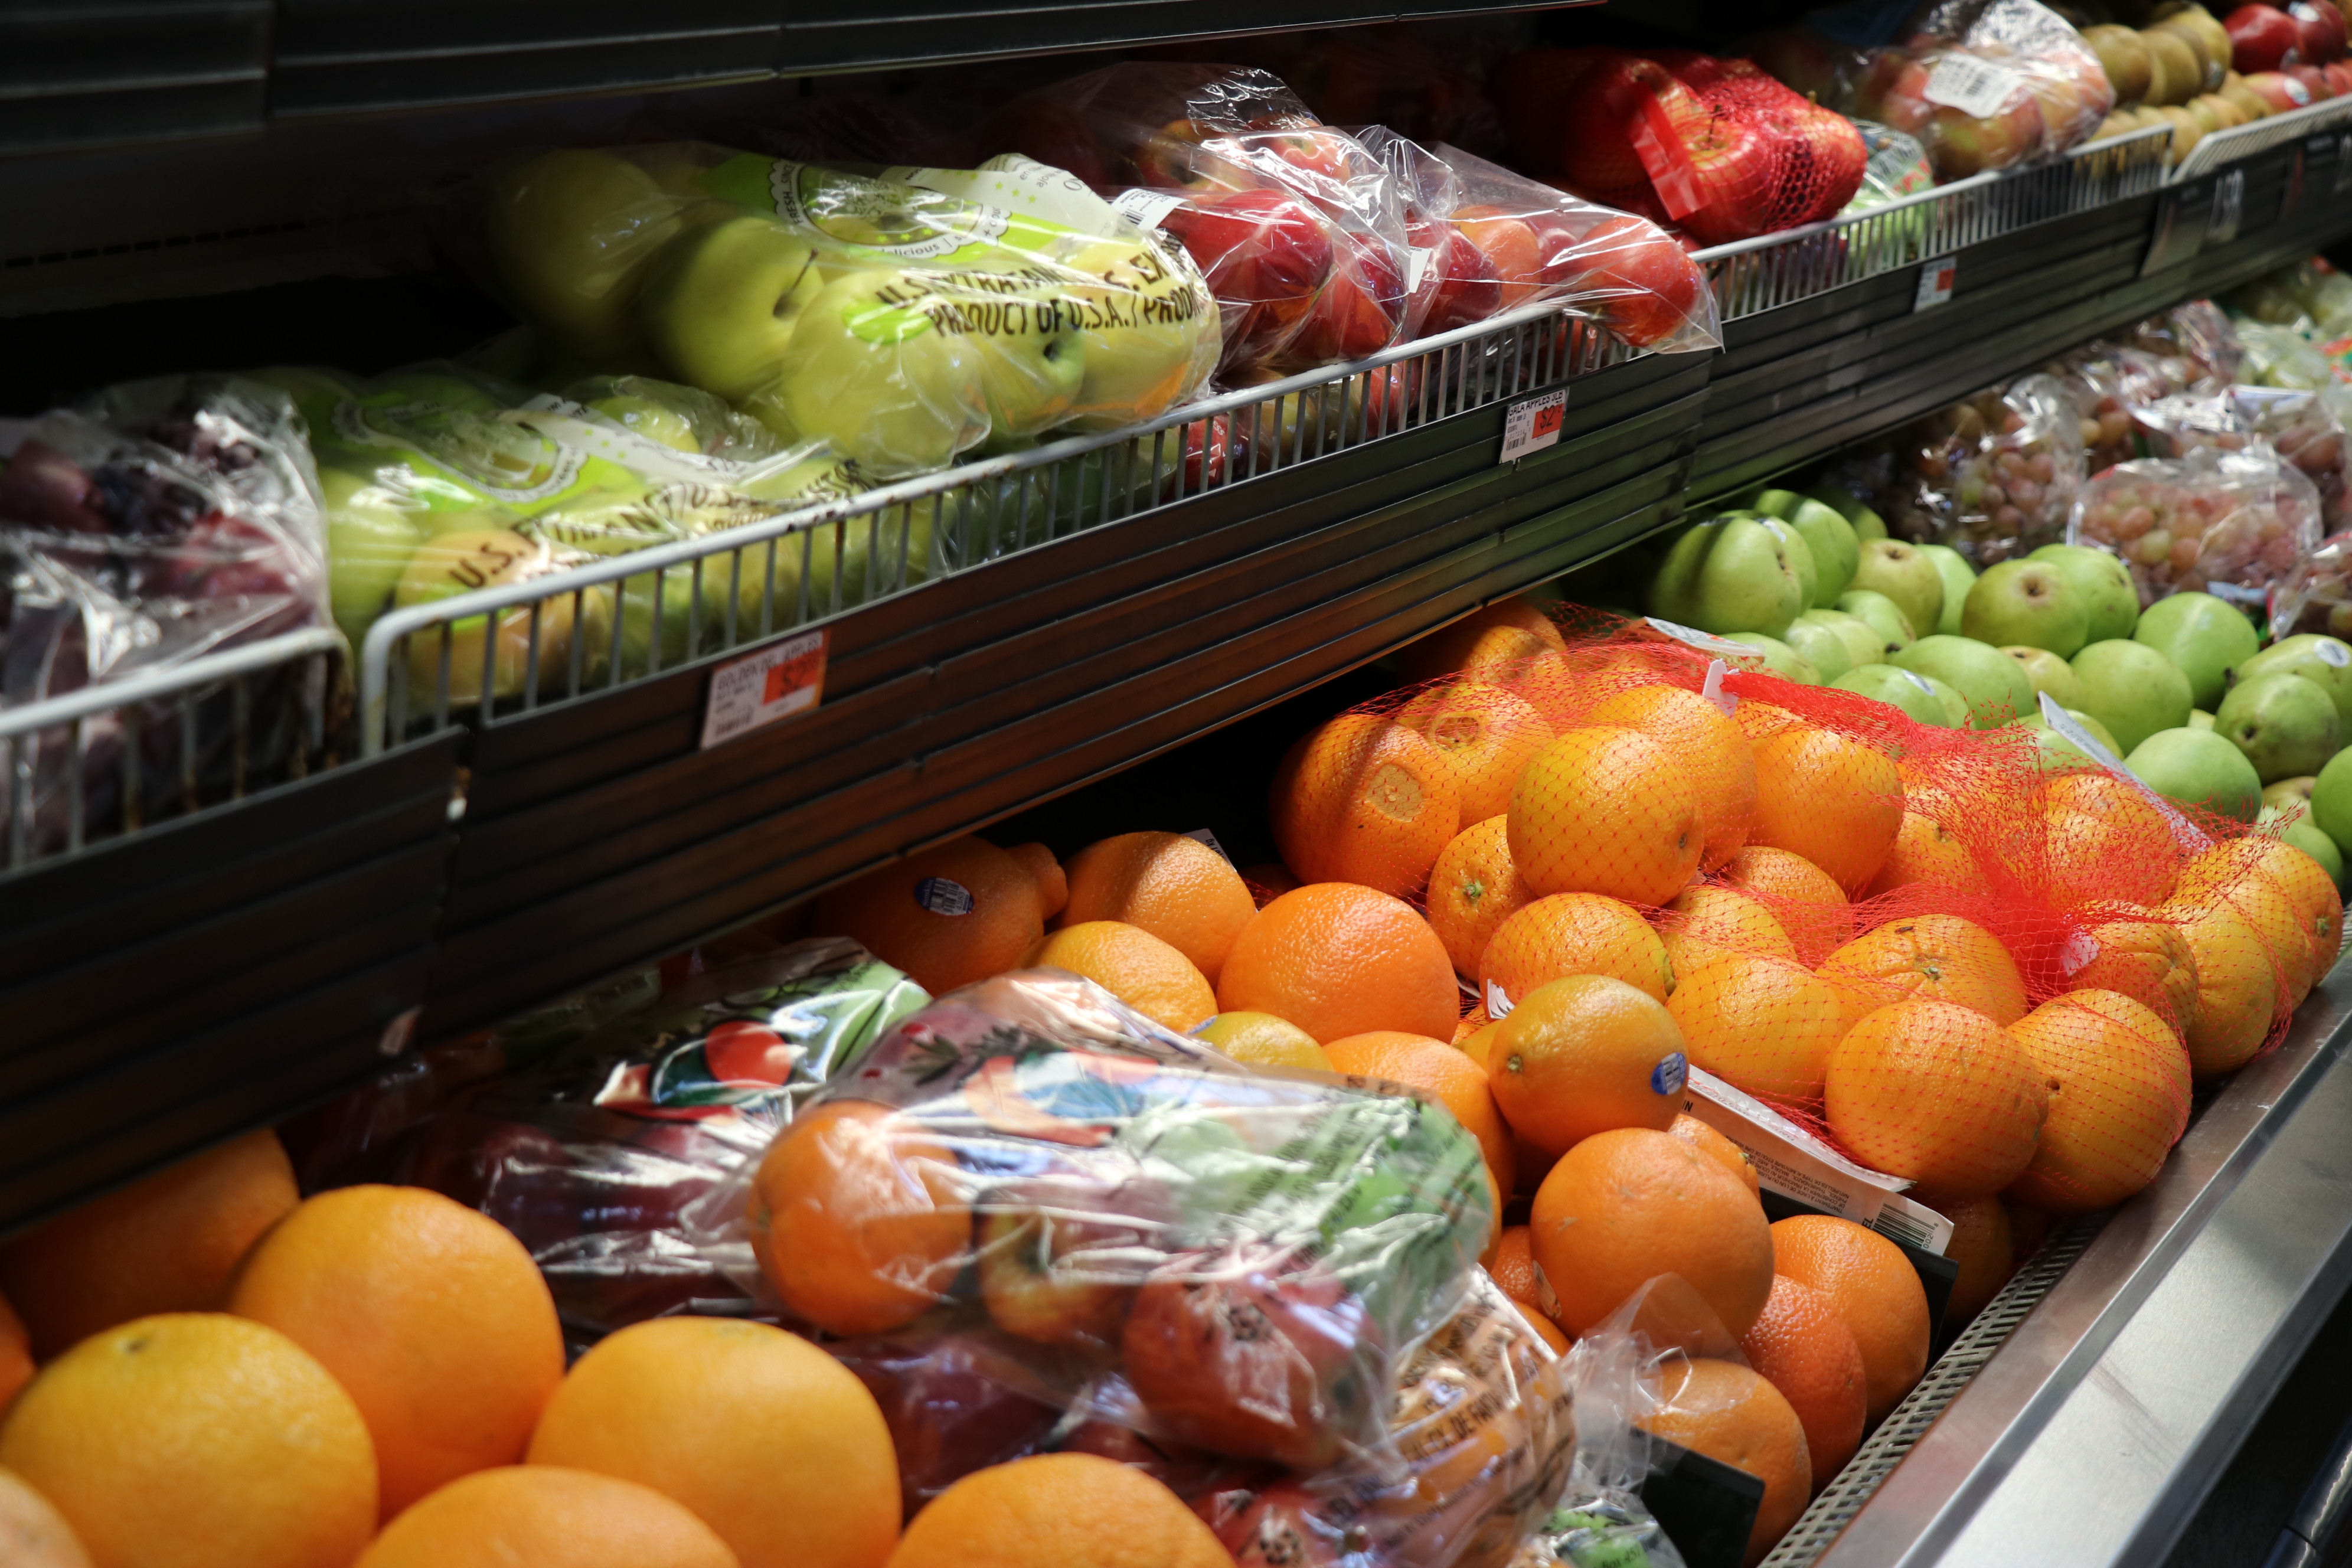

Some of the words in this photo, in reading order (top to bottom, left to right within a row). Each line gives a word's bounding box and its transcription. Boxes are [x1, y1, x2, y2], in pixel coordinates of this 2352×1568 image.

[924, 302, 1029, 337] PRODUCT
[1036, 298, 1063, 334] OF
[1508, 404, 1525, 417] GALA
[1525, 394, 1551, 411] APPLES
